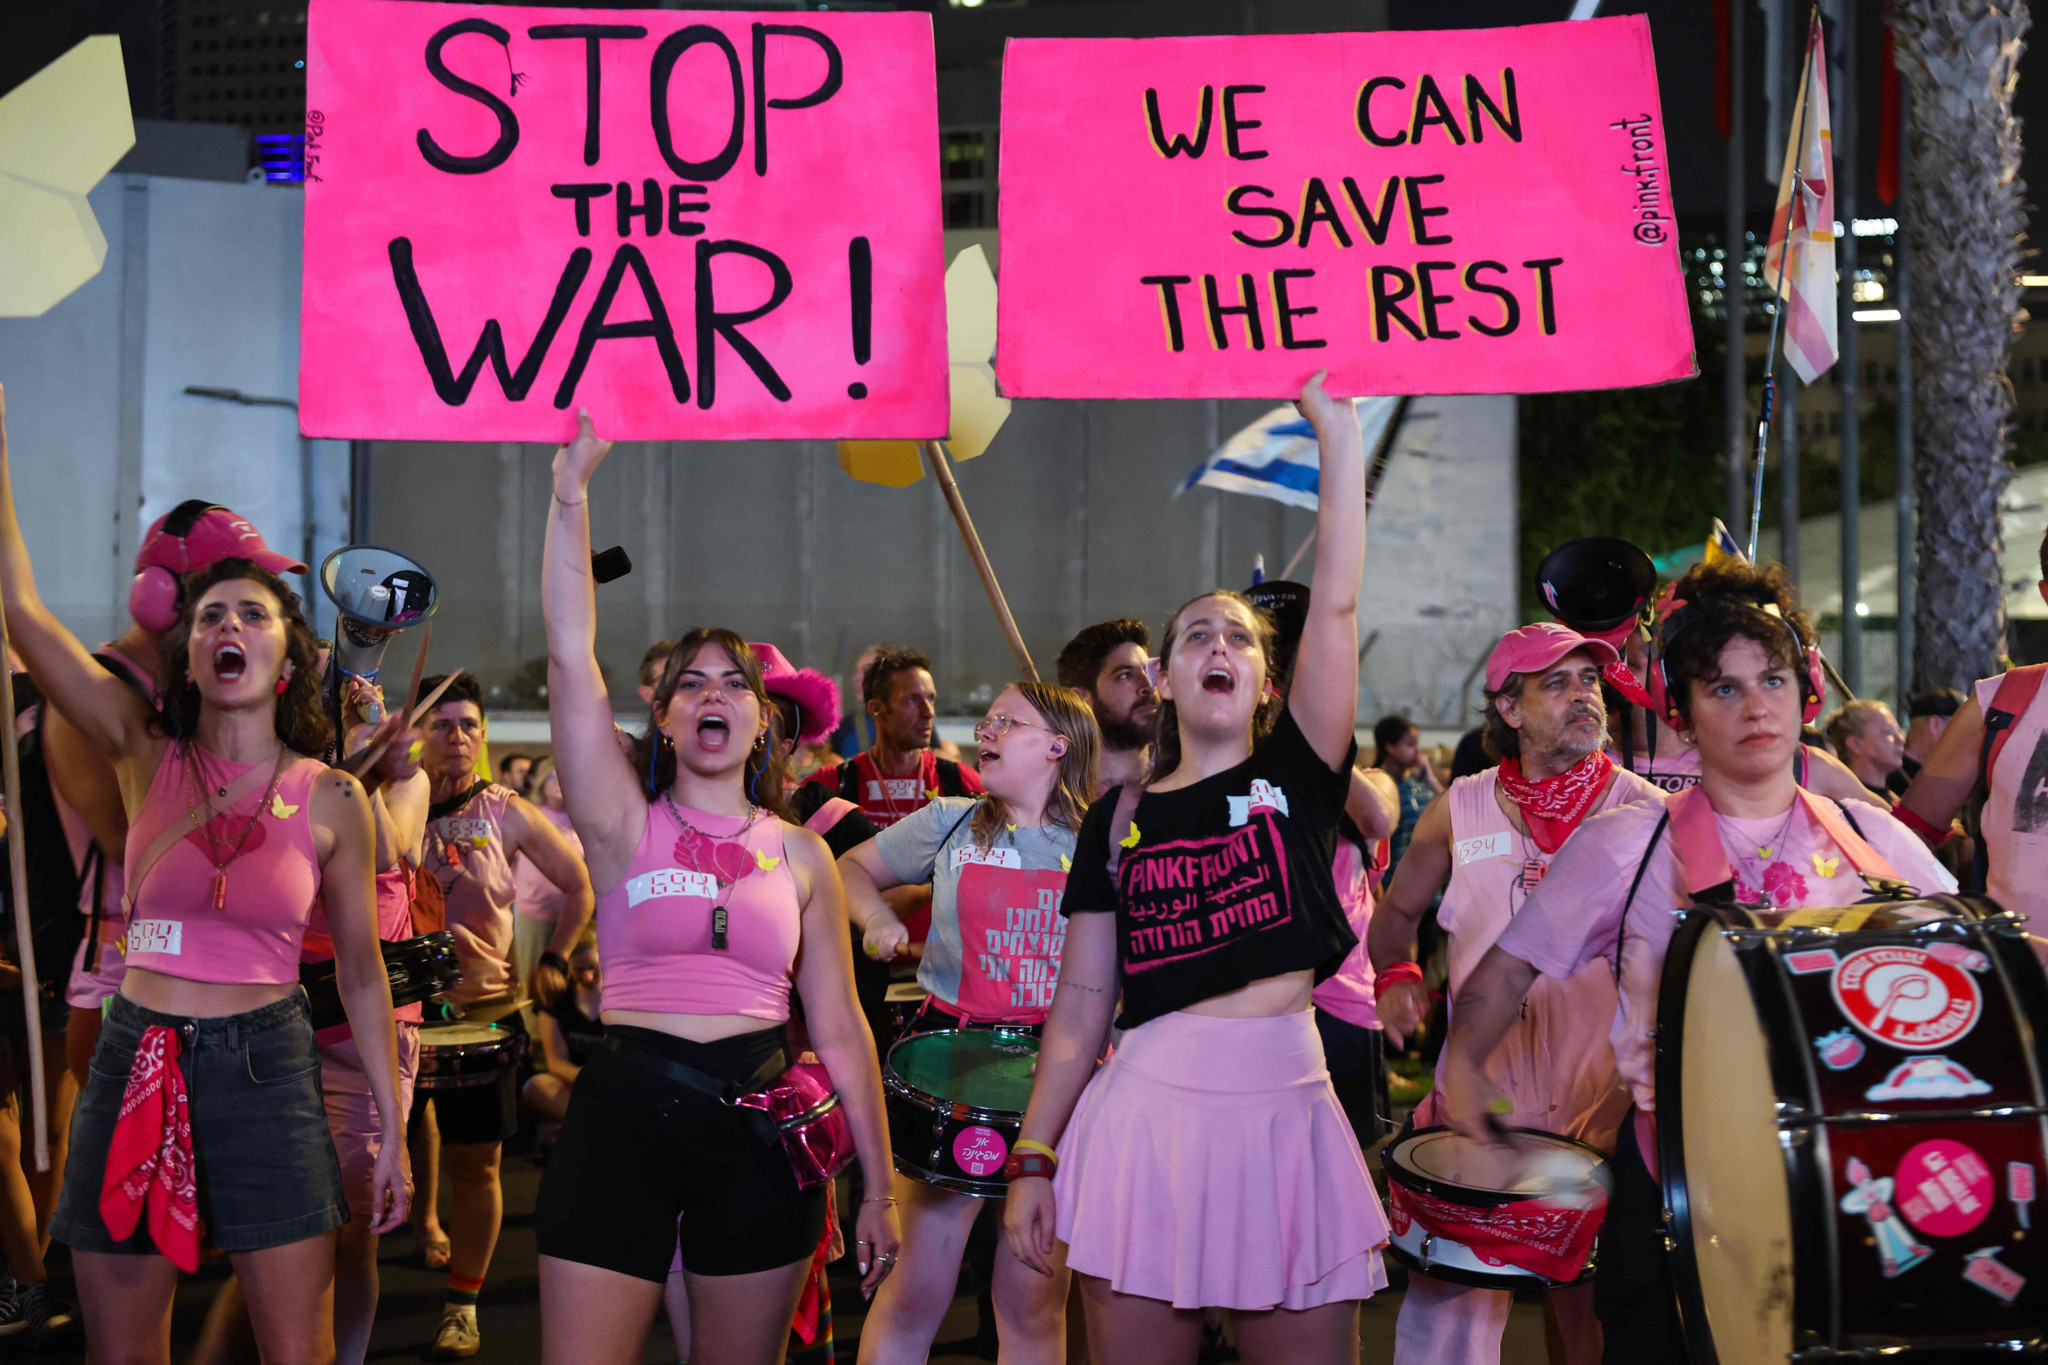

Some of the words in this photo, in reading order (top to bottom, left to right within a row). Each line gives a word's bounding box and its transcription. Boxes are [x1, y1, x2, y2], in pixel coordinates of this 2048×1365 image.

[416, 18, 843, 182] STOP
[1143, 84, 1268, 160] WE
[1356, 67, 1523, 146] CAN
[1610, 113, 1671, 246] @pink.front
[550, 177, 711, 237] THE
[1224, 174, 1453, 249] SAVE
[1141, 268, 1327, 351] THE
[1366, 257, 1564, 343] REST
[1460, 837, 1495, 860] 694
[652, 872, 708, 895] 694
[1205, 863, 1270, 904] الجبهة
[1006, 908, 1068, 934] אנחנו
[1128, 893, 1197, 921] الوردية
[1209, 892, 1279, 938] החזית
[131, 922, 172, 951] 694
[985, 929, 1065, 956] מנצחים
[1130, 919, 1202, 955] הורודה
[979, 955, 1010, 982] אני
[1020, 956, 1061, 983] למה
[962, 1148, 1000, 1160] מפגינה
[971, 1137, 990, 1148] אני
